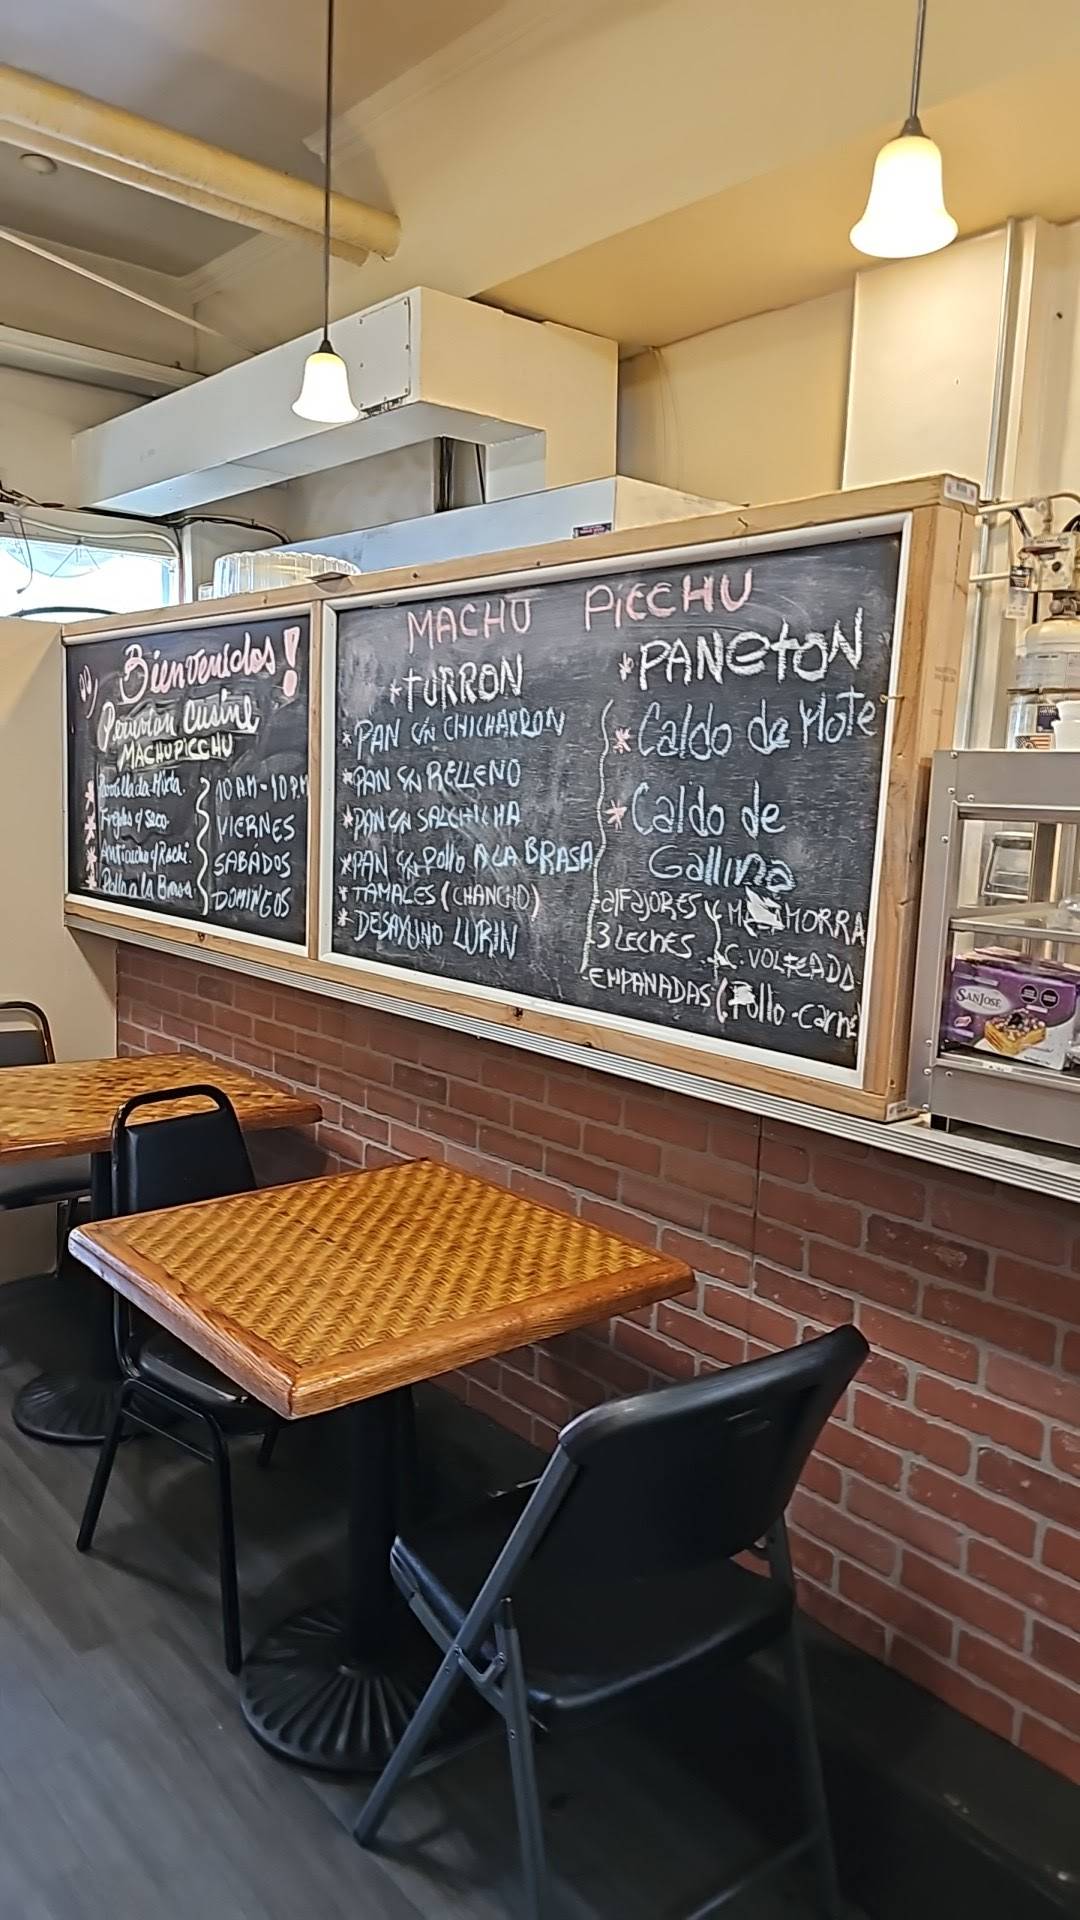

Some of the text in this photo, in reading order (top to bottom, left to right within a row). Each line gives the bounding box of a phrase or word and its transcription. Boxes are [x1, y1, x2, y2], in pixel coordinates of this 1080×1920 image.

[408, 599, 531, 654] MACHU
[354, 718, 400, 760] PAN
[638, 701, 732, 760] Caldo
[748, 699, 790, 755] de
[215, 778, 232, 802] 10
[271, 773, 288, 802] 10
[354, 766, 391, 797] PAN
[426, 759, 521, 792] RELLENO
[217, 812, 295, 842] VIERNES
[353, 806, 385, 841] PAN
[632, 780, 786, 840] Caldo de
[352, 847, 389, 880] PAN
[525, 837, 593, 876] BRASA
[649, 845, 797, 893] Gallina
[211, 884, 291, 918] DOMINGOS
[352, 884, 436, 905] TAMALES
[354, 910, 518, 961] DESAYUNO LURIN
[596, 922, 611, 948] 3
